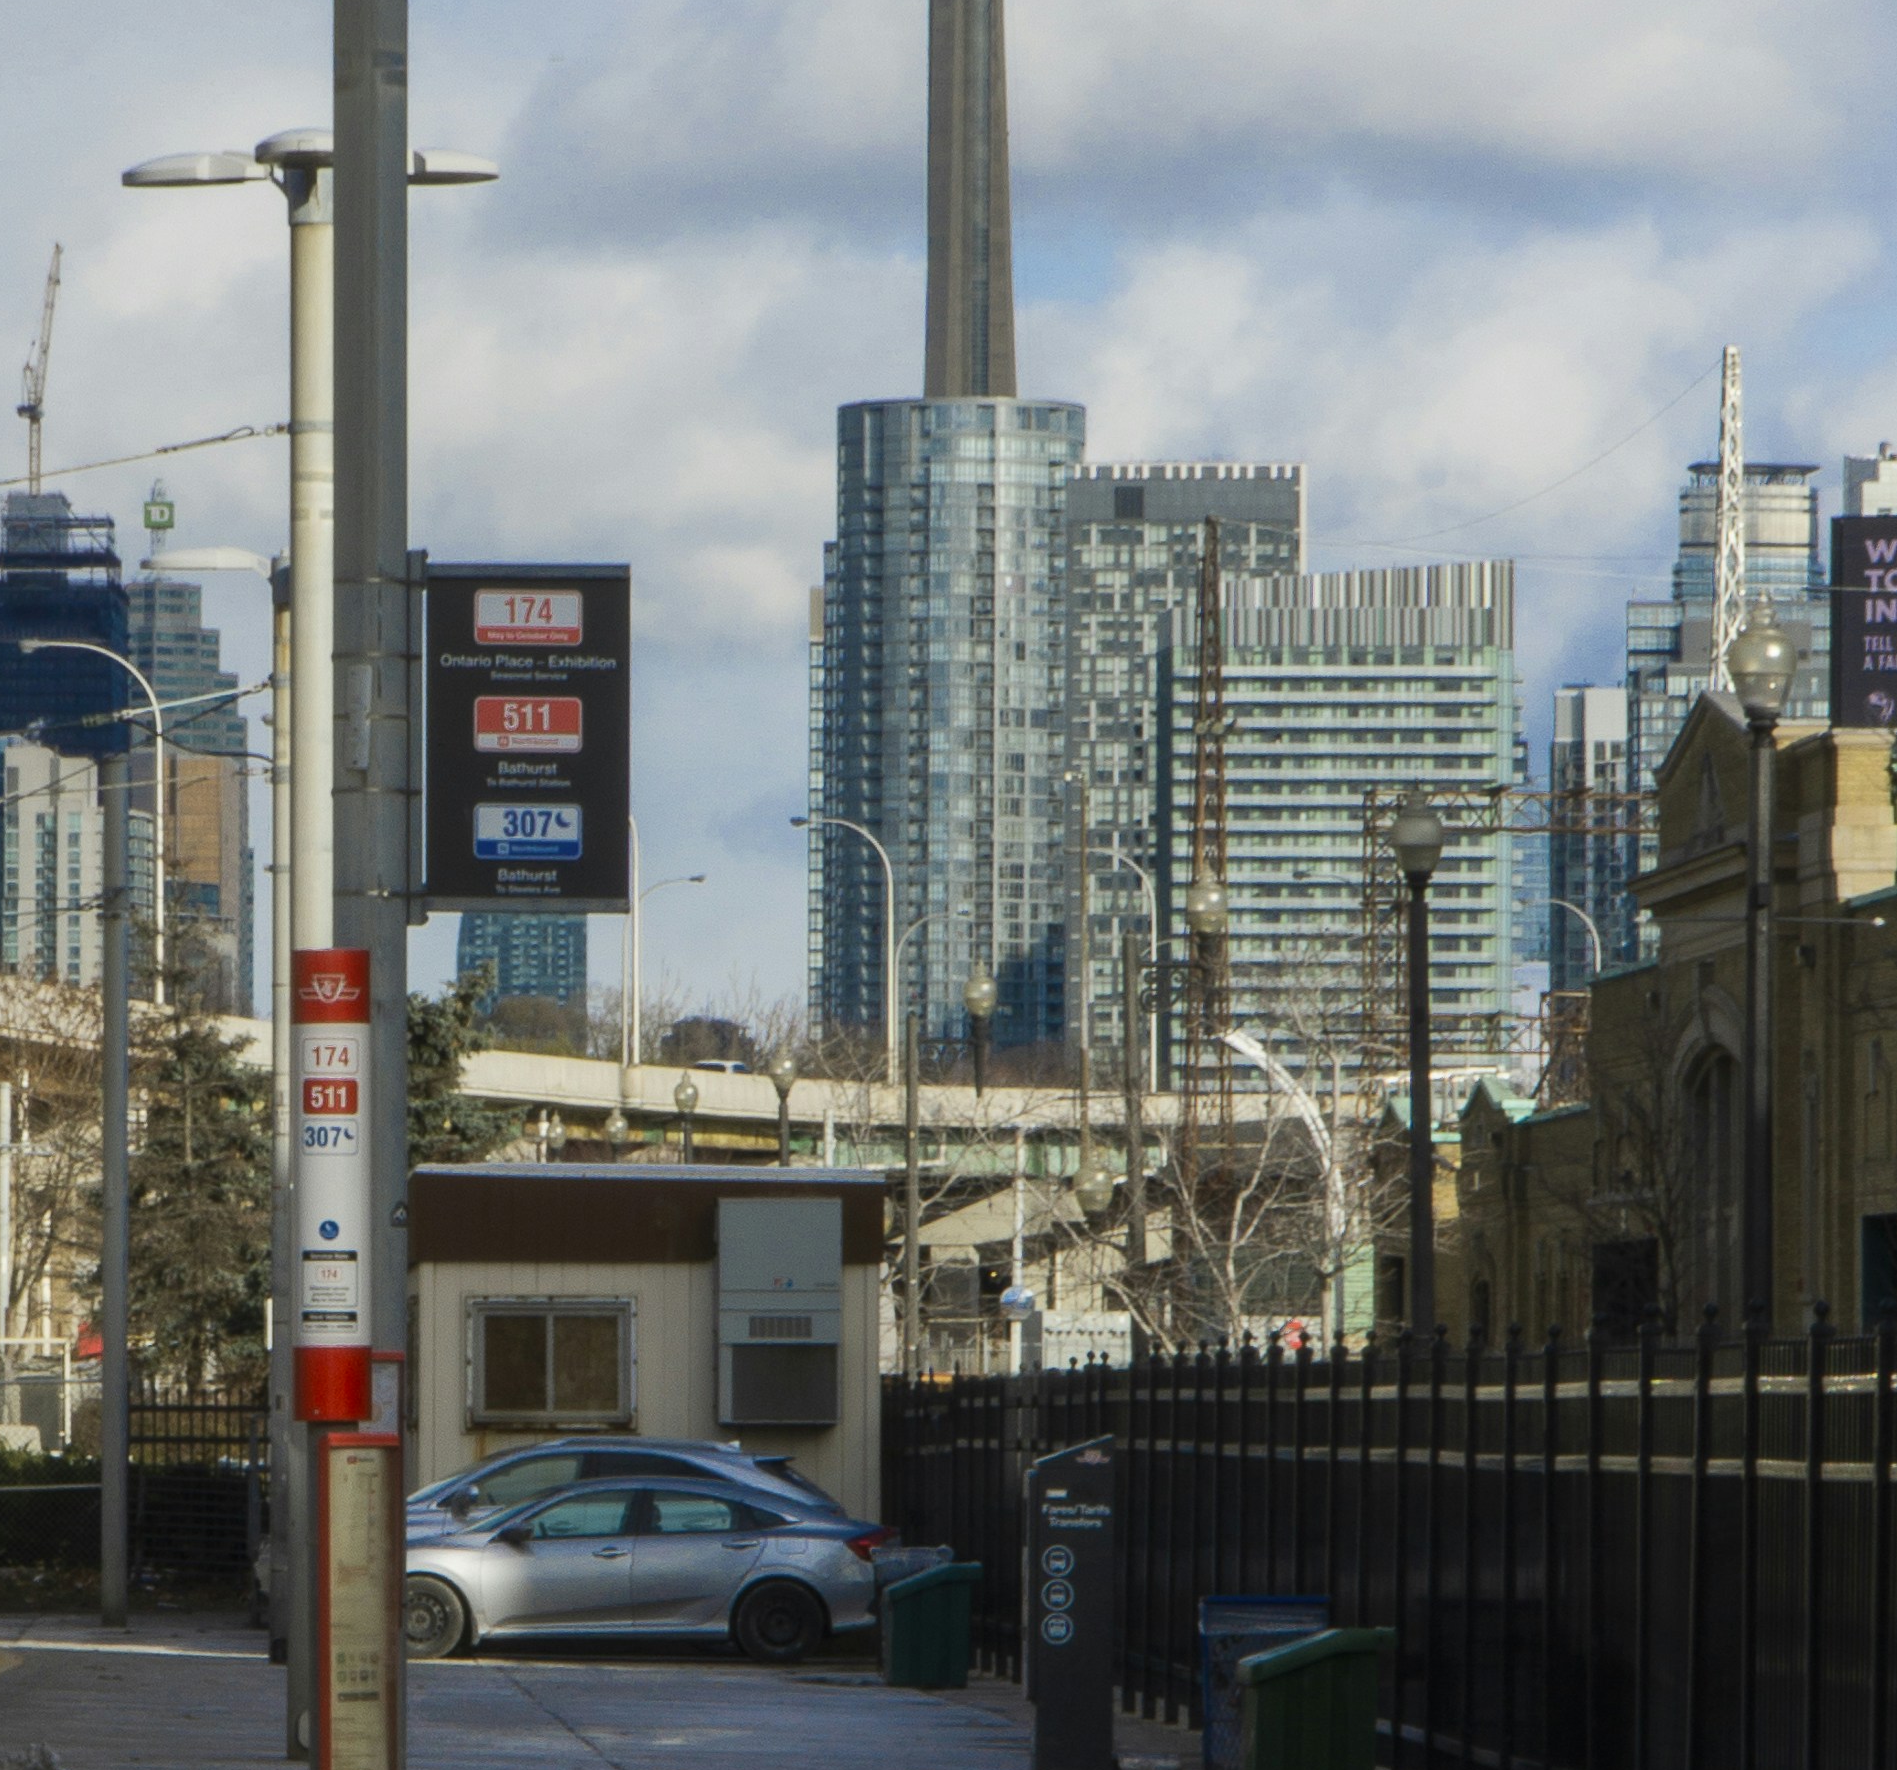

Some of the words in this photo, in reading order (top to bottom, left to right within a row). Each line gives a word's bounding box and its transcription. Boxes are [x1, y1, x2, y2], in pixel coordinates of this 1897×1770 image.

[146, 506, 169, 521] TD
[504, 596, 553, 624] 174
[440, 654, 491, 668] Ontario
[495, 654, 534, 668] Place
[548, 655, 617, 669] Exhibition
[1878, 654, 1897, 670] FA
[504, 703, 550, 731] 511
[498, 761, 557, 775] Bathurst
[503, 810, 553, 837] 307
[497, 868, 557, 882] Bathurst
[312, 1046, 349, 1067] 174
[310, 1086, 347, 1108] 511
[305, 1126, 342, 1147] 307
